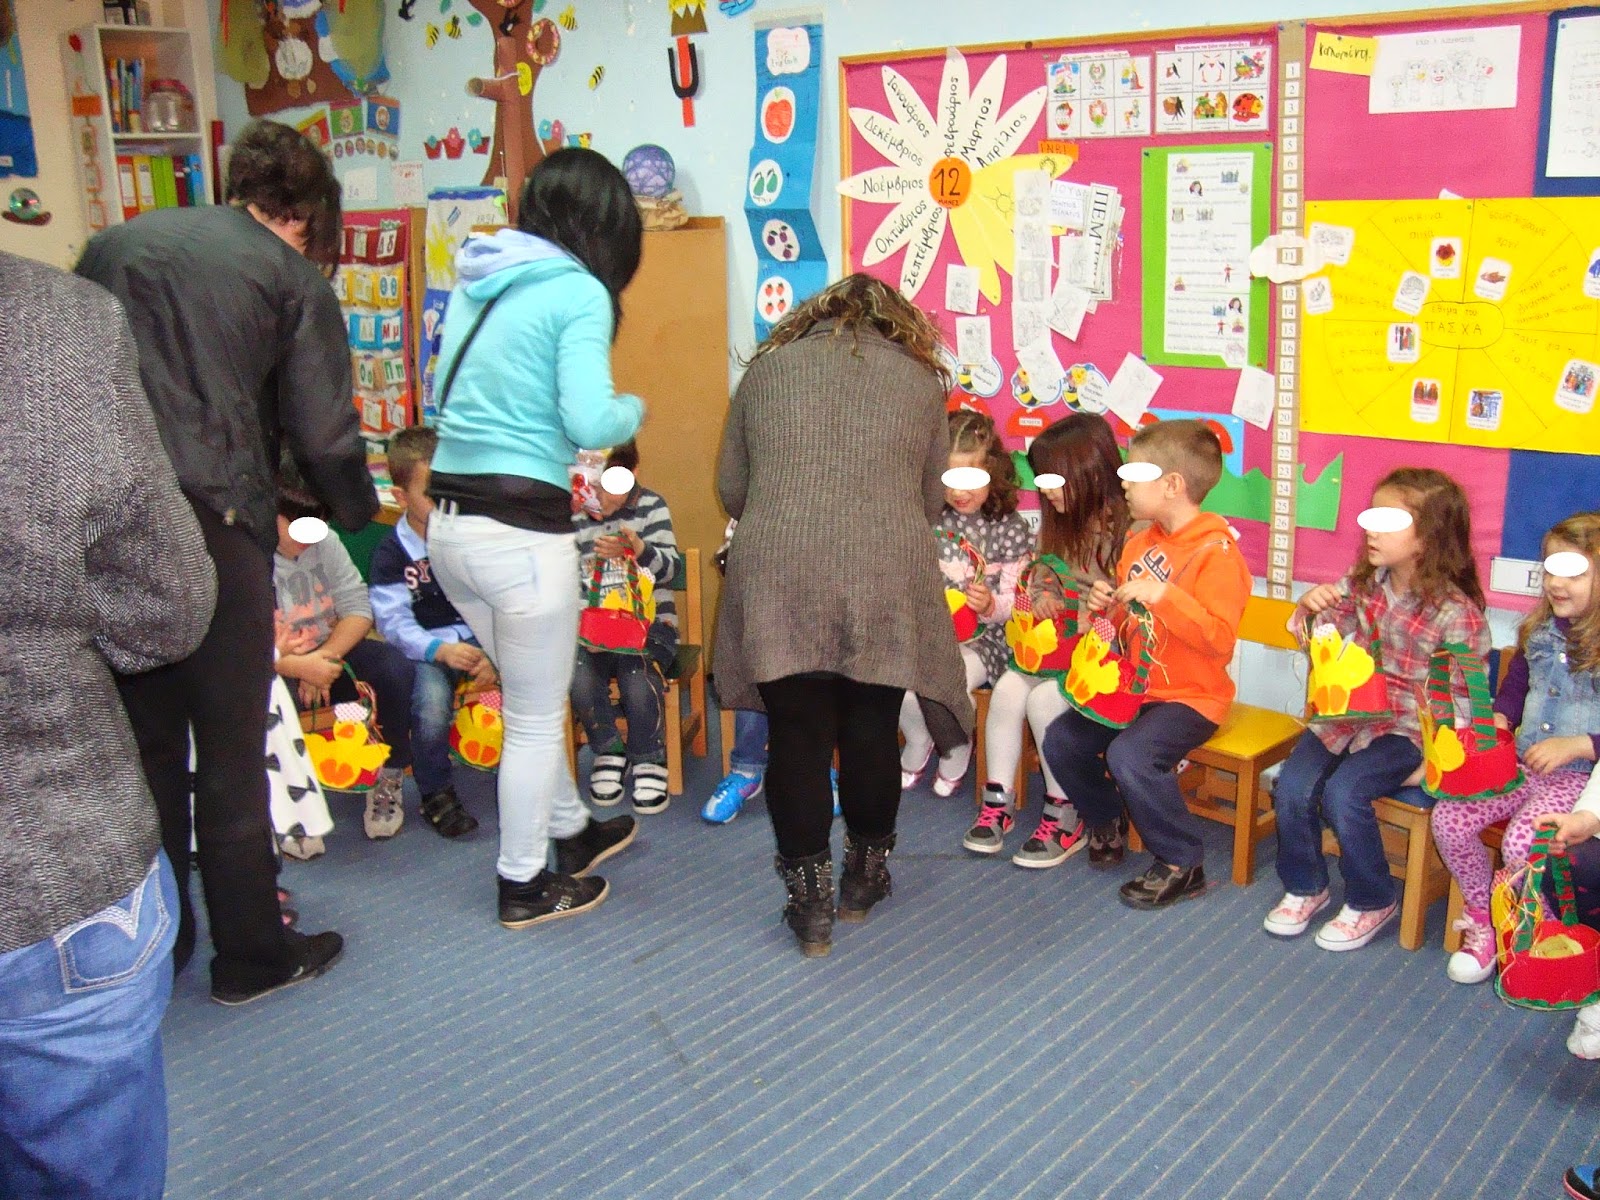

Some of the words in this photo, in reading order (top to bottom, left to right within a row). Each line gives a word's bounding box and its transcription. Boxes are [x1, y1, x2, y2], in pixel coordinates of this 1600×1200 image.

[1290, 65, 1295, 75] 1
[1289, 85, 1295, 95] 2
[887, 75, 930, 138] Ιανουάριος
[1288, 103, 1294, 113] 3
[960, 98, 992, 162] Μάρτιος
[1287, 121, 1293, 131] 4
[864, 115, 922, 167] Δεκέμβριος
[976, 114, 1027, 168] Απρίλιος
[1287, 140, 1293, 150] 5
[1287, 158, 1293, 168] 6
[863, 174, 924, 198] Νοέμβριος
[934, 168, 960, 196] 12
[1287, 176, 1293, 186] 7
[1287, 195, 1293, 205] 8
[1286, 213, 1292, 223] 9
[875, 200, 927, 254] Οκτώβριος
[904, 206, 942, 288] Σεπτέμβριος
[1284, 250, 1294, 260] 11
[1283, 288, 1295, 298] 13
[1282, 307, 1295, 317] 14
[1281, 325, 1294, 335] 15
[1424, 321, 1482, 336] ΠΑΣΧΑ
[1281, 342, 1294, 352] 16
[1281, 359, 1293, 369] 17
[1280, 377, 1293, 387] 18
[1280, 395, 1292, 405] 19
[1278, 413, 1291, 423] 20
[1278, 431, 1290, 441] 21
[1278, 449, 1290, 459] 22
[1278, 466, 1290, 476] 23
[1277, 484, 1290, 494] 24
[1276, 501, 1288, 511] 25
[1275, 517, 1288, 527] 26
[1275, 536, 1287, 546] 27
[1274, 554, 1286, 564] 28
[1273, 571, 1286, 581] 29
[1272, 587, 1285, 597] 30
